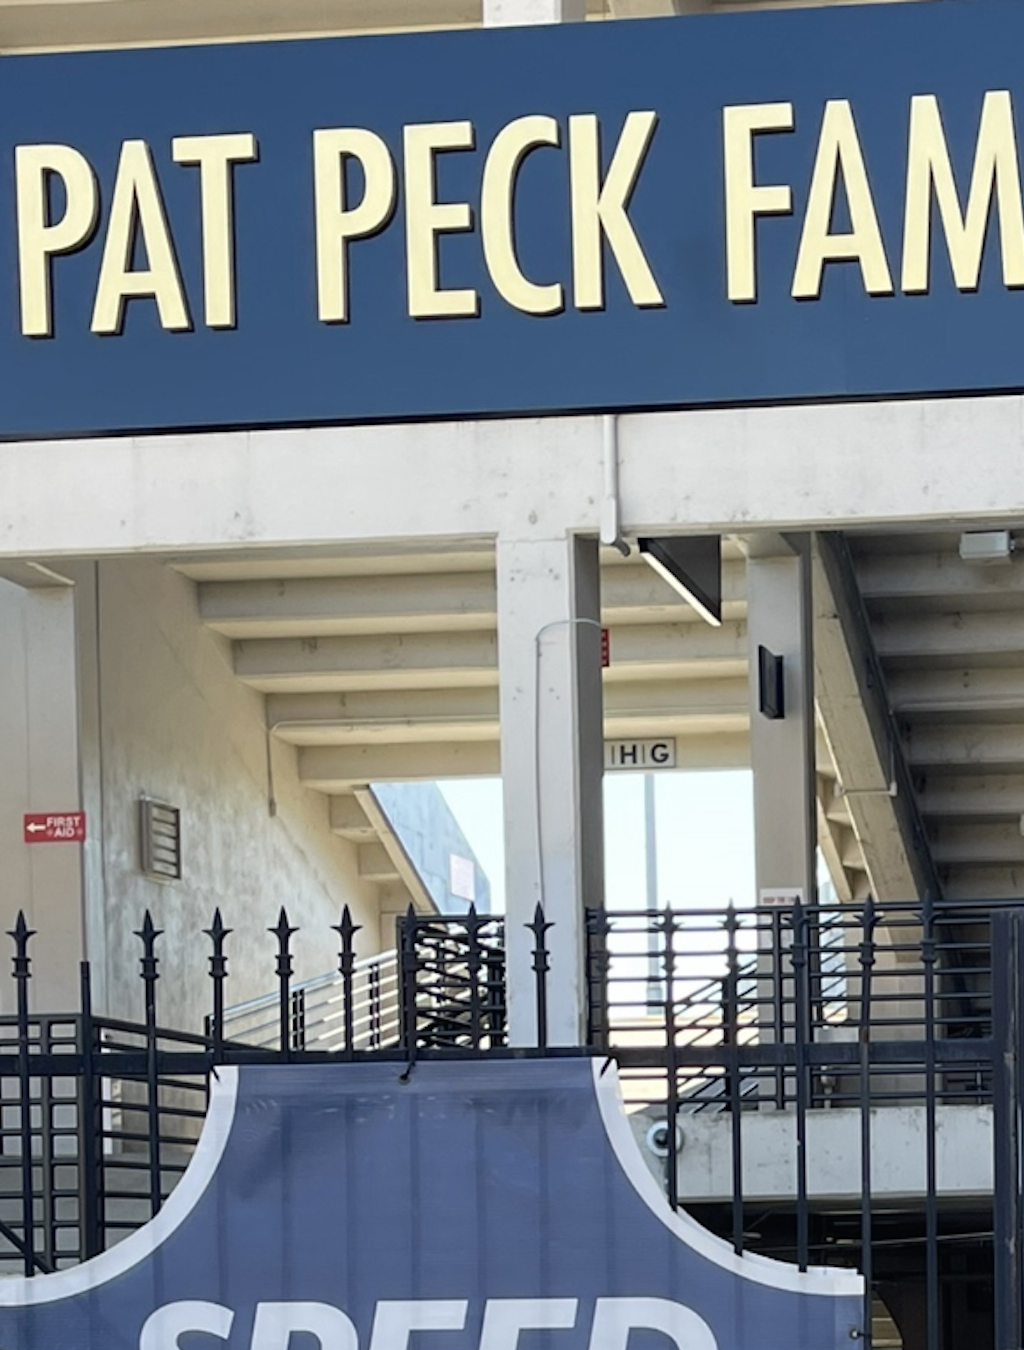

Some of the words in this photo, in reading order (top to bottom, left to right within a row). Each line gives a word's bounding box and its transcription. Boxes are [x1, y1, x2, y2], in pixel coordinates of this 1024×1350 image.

[14, 131, 260, 339] PAT
[312, 109, 666, 325] PECK
[46, 816, 81, 828] FIRST
[53, 828, 75, 838] AID
